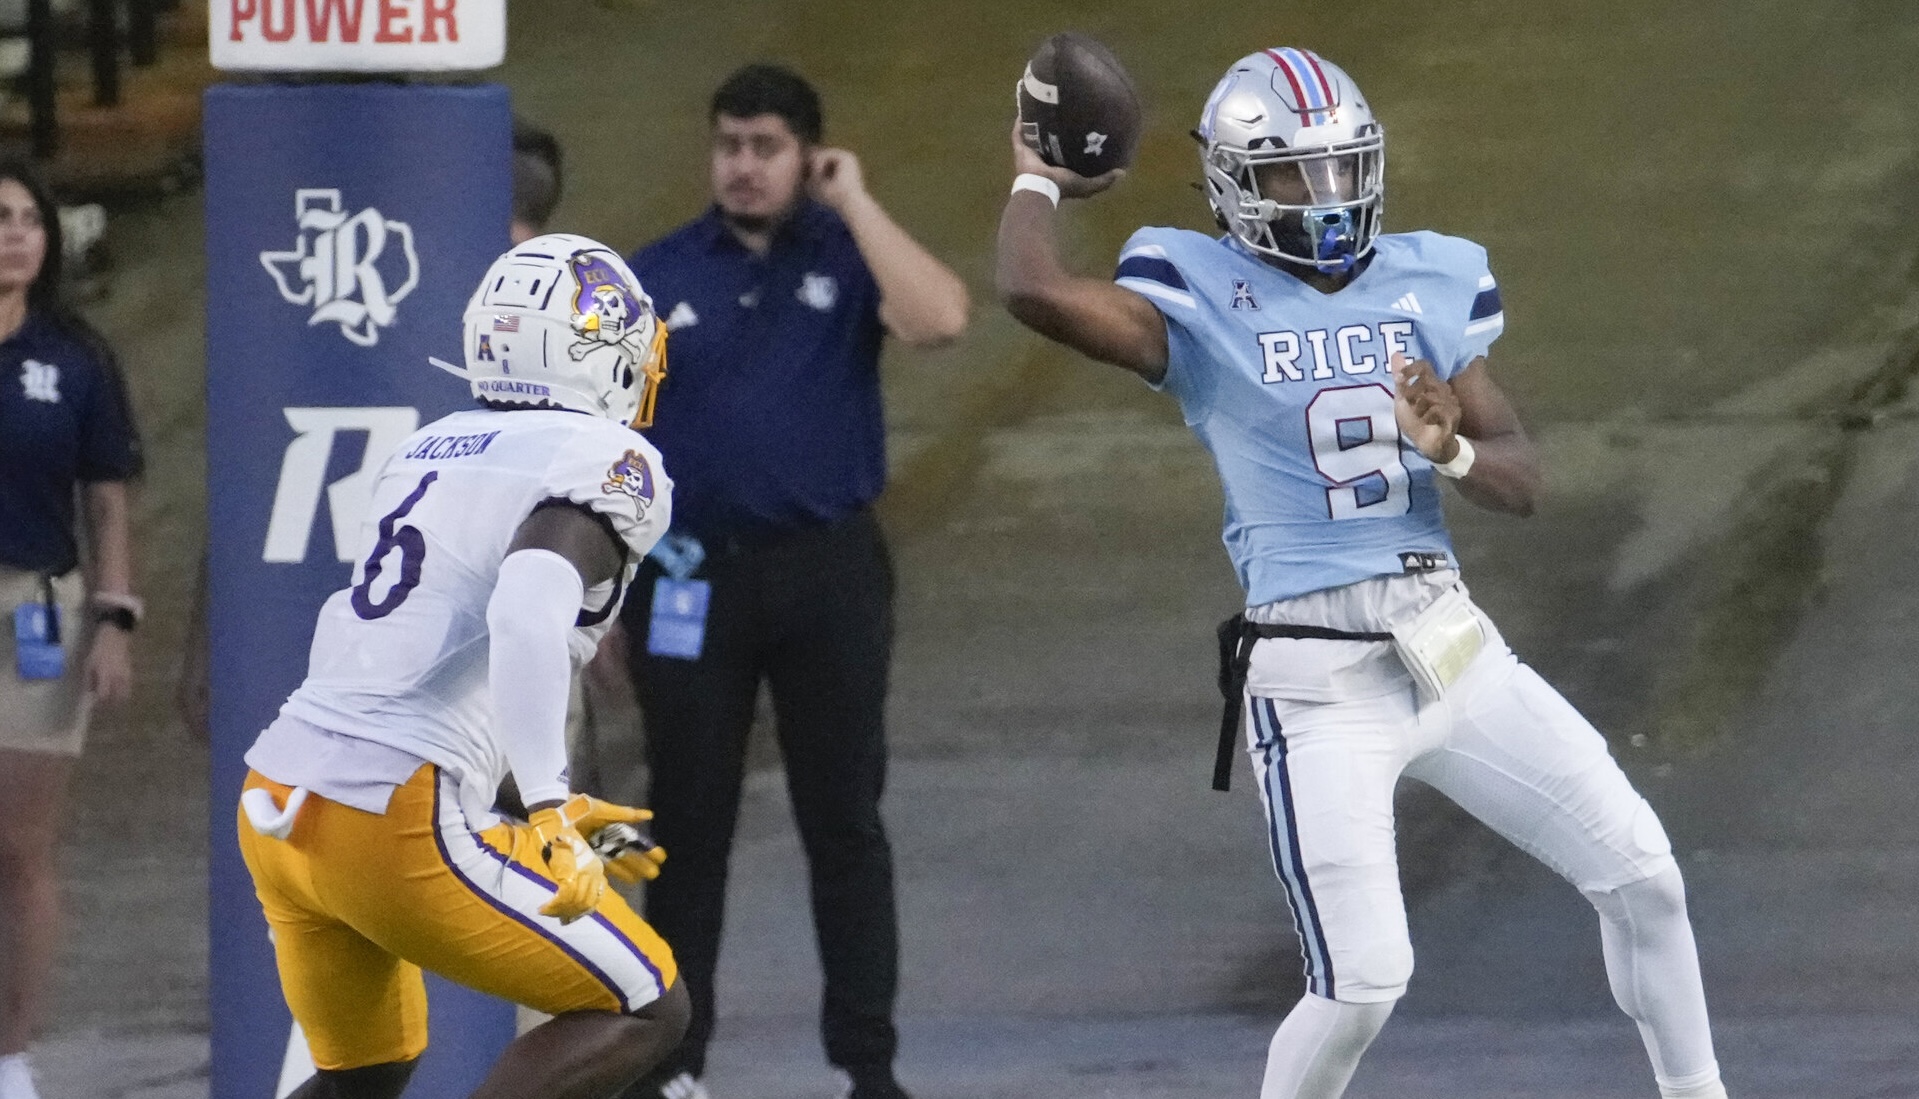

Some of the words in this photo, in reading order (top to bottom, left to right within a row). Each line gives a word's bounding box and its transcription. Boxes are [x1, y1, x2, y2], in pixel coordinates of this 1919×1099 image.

[229, 0, 459, 43] POWER
[1257, 320, 1414, 385] RICE
[491, 380, 551, 397] QUARTER
[405, 430, 502, 460] JACKSON
[1305, 382, 1413, 520] 9
[351, 470, 426, 620] 6
